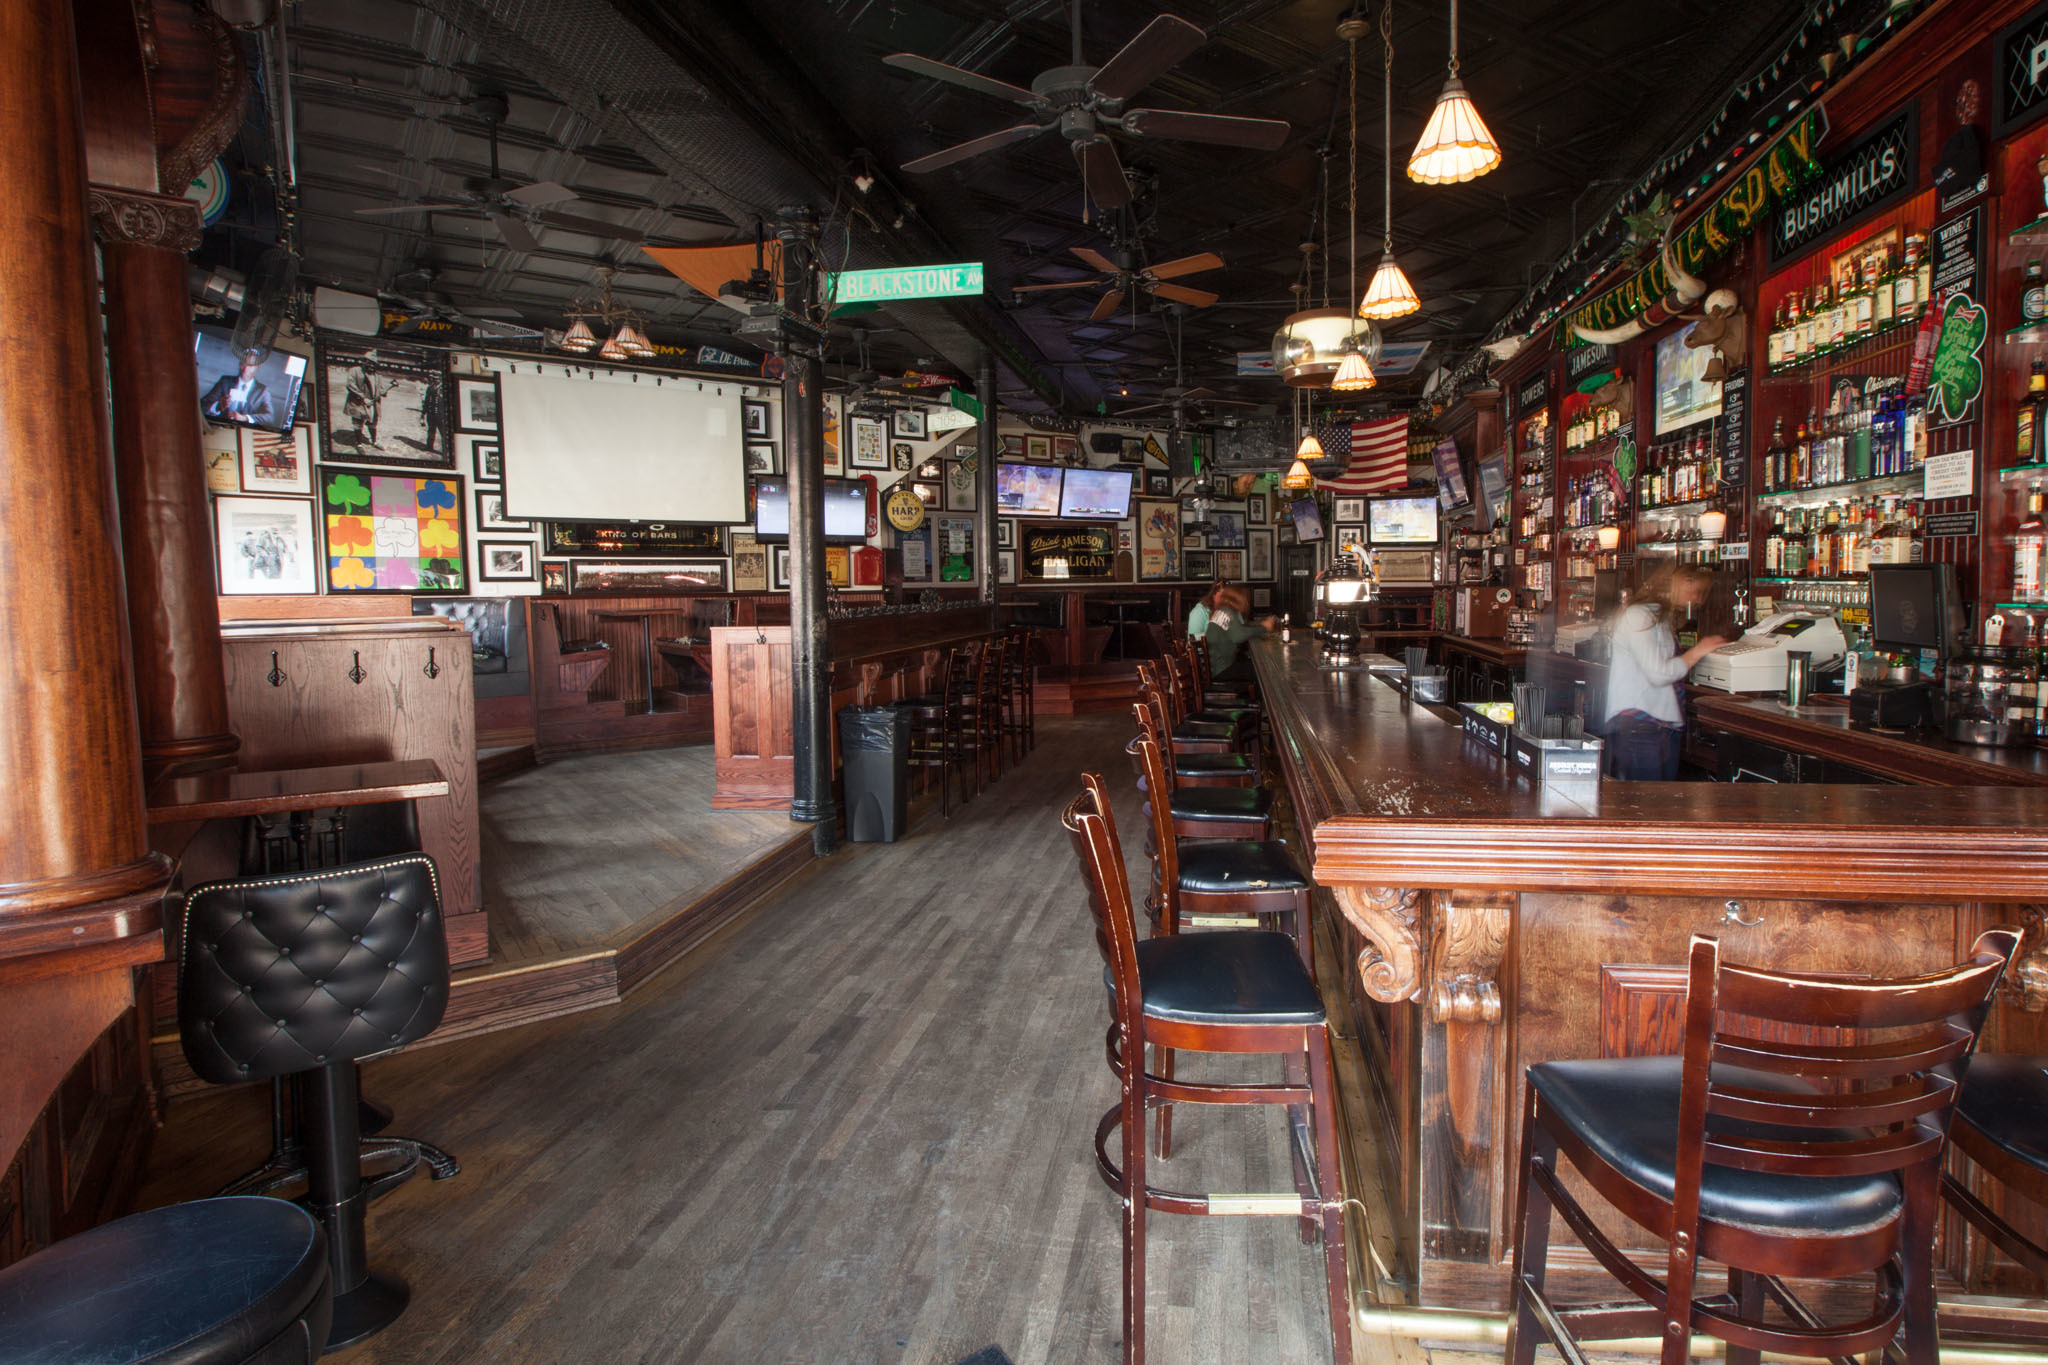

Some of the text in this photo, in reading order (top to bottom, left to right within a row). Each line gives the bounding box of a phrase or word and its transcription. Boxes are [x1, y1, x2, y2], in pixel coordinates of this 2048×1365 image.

[1746, 119, 1809, 226] DAY
[1784, 146, 1896, 241] BUSHMILLS
[845, 268, 964, 299] BLACKSTONE
[1941, 276, 1973, 298] OSCOW
[651, 344, 688, 356] RMY
[719, 351, 733, 365] DE
[1570, 343, 1609, 377] JAMESON
[1521, 379, 1546, 408] POWERS
[1863, 375, 1900, 394] Chicgo
[891, 506, 920, 516] HARP
[601, 531, 627, 539] KING
[631, 531, 646, 539] OF
[1031, 534, 1105, 550] Drink JAMESON
[1043, 555, 1105, 567] HALLIGAN
